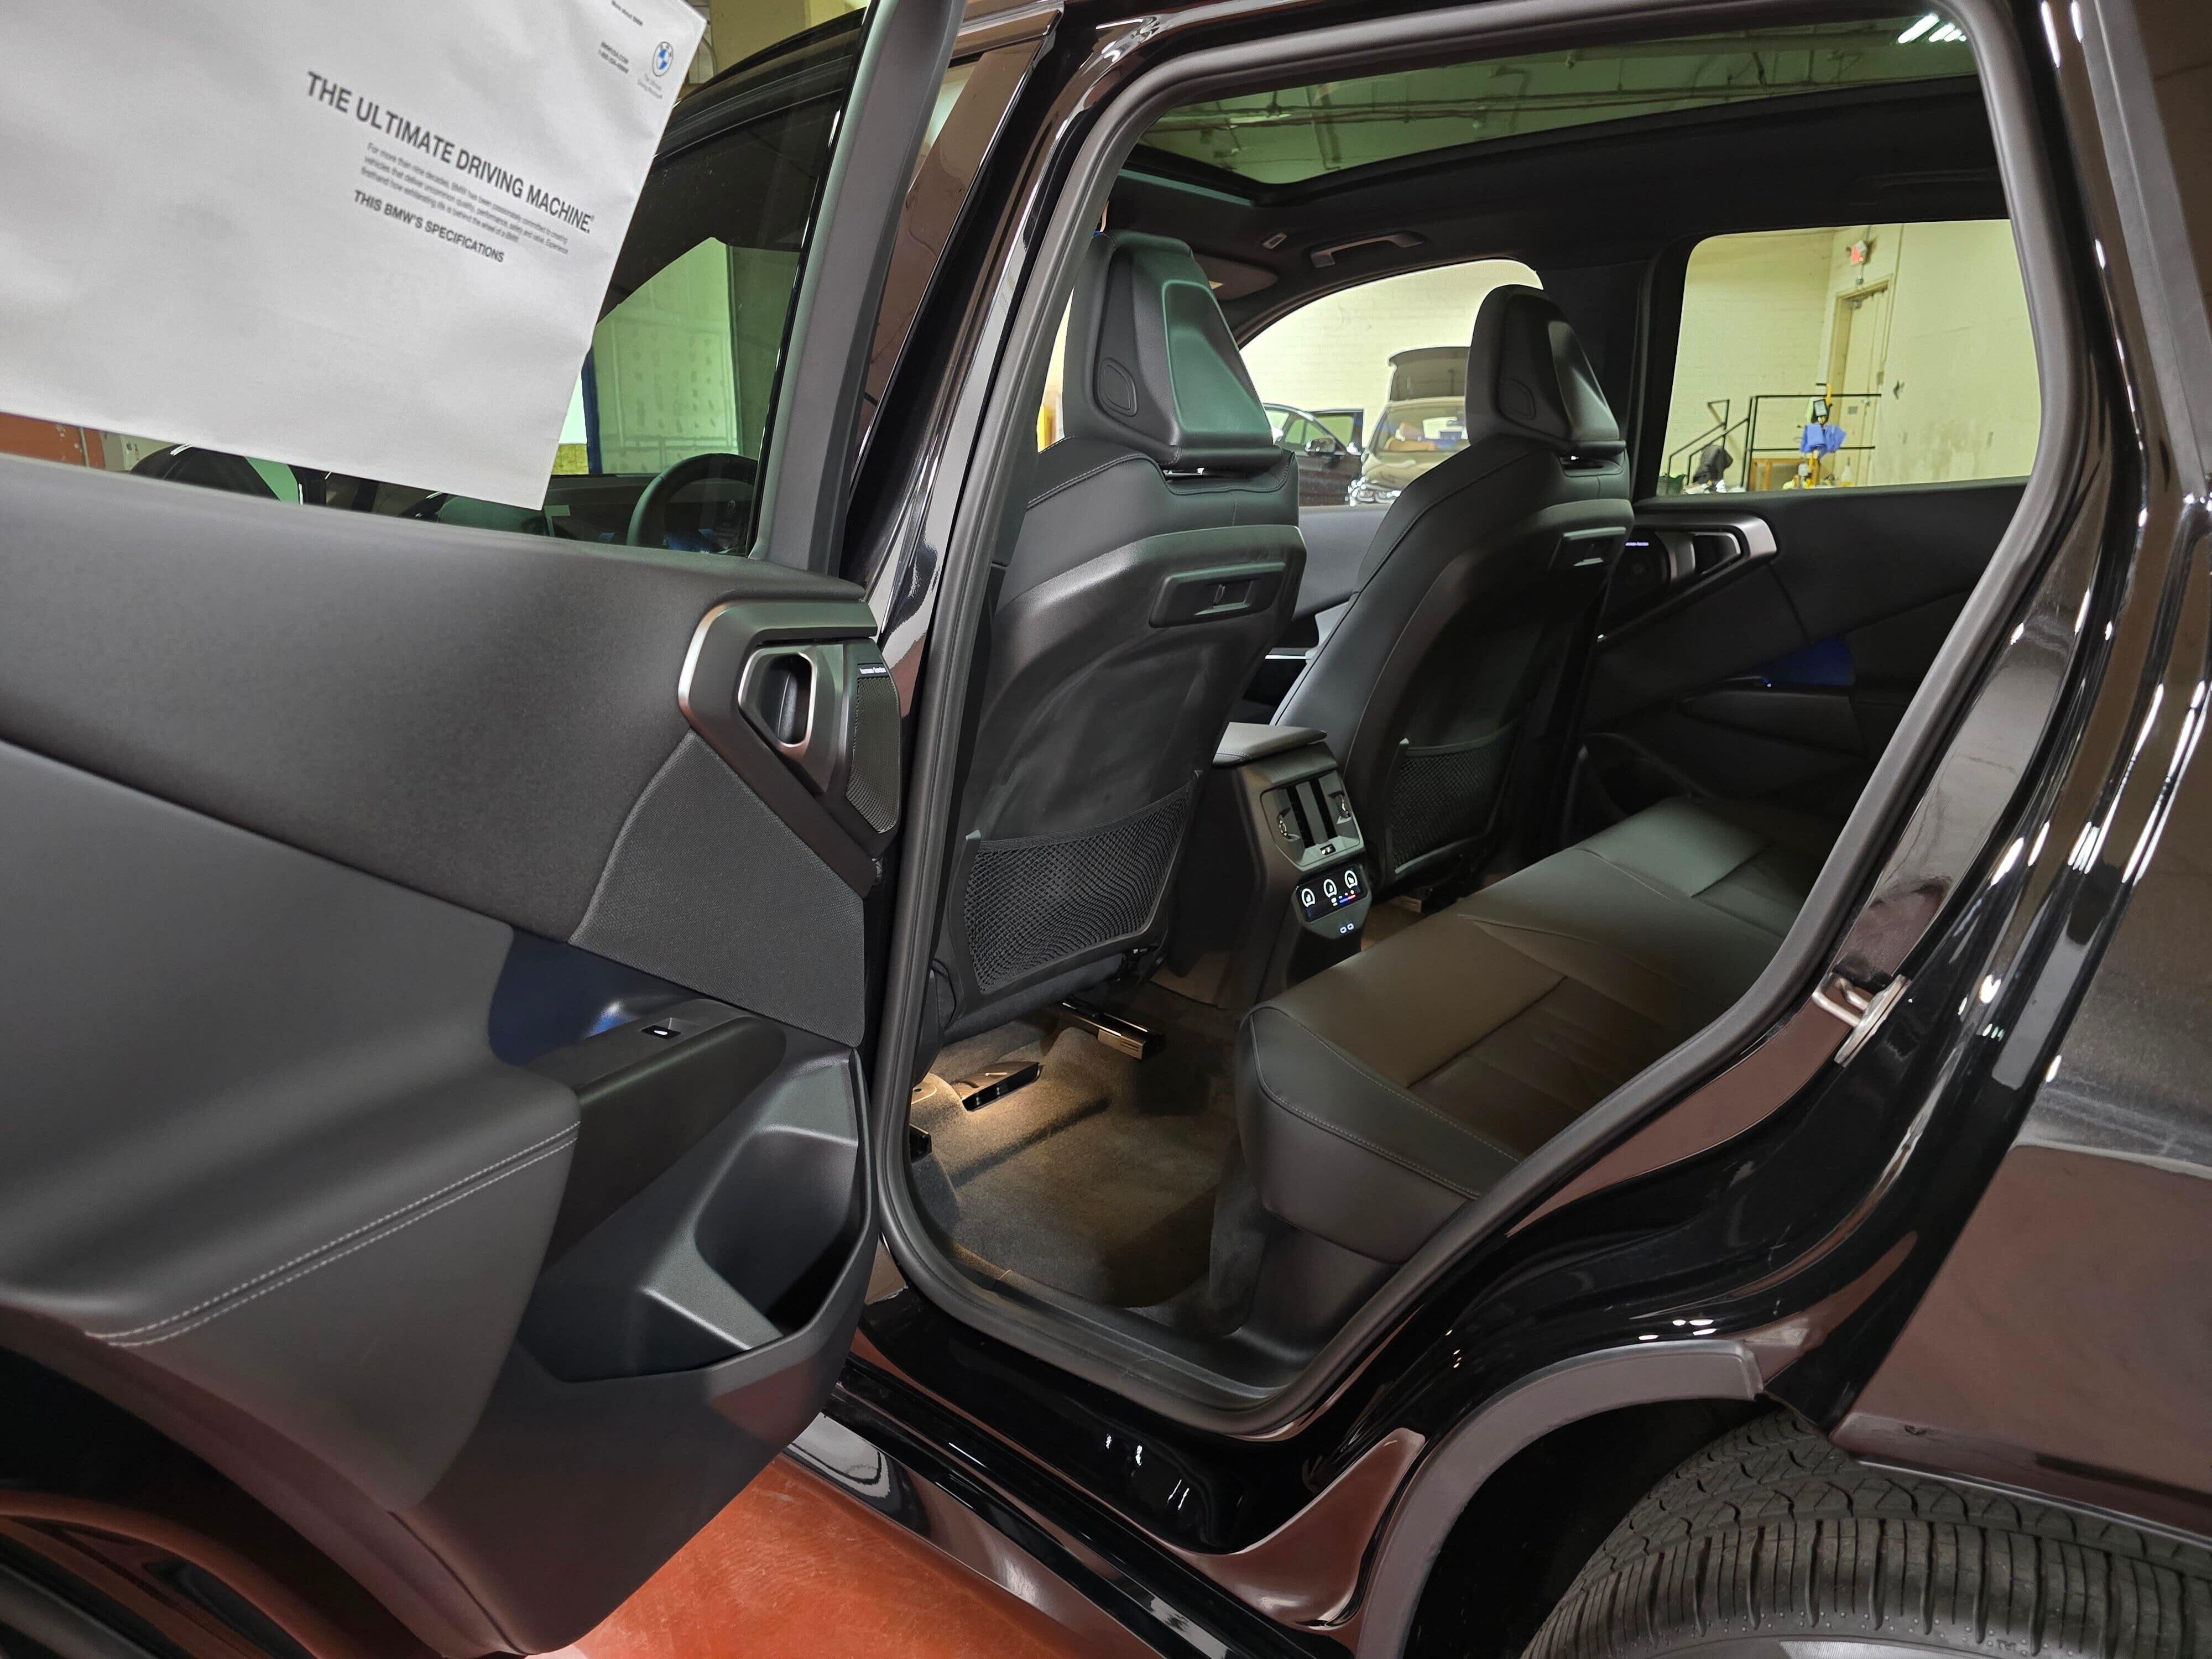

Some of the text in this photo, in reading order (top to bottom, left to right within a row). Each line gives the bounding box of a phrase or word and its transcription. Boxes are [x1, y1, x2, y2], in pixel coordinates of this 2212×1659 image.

[307, 71, 352, 113] THE
[356, 97, 456, 164] ULTIMATE
[456, 149, 523, 199] DRIVING
[354, 190, 505, 263] THIS BMW'S SPECIFICATIONS
